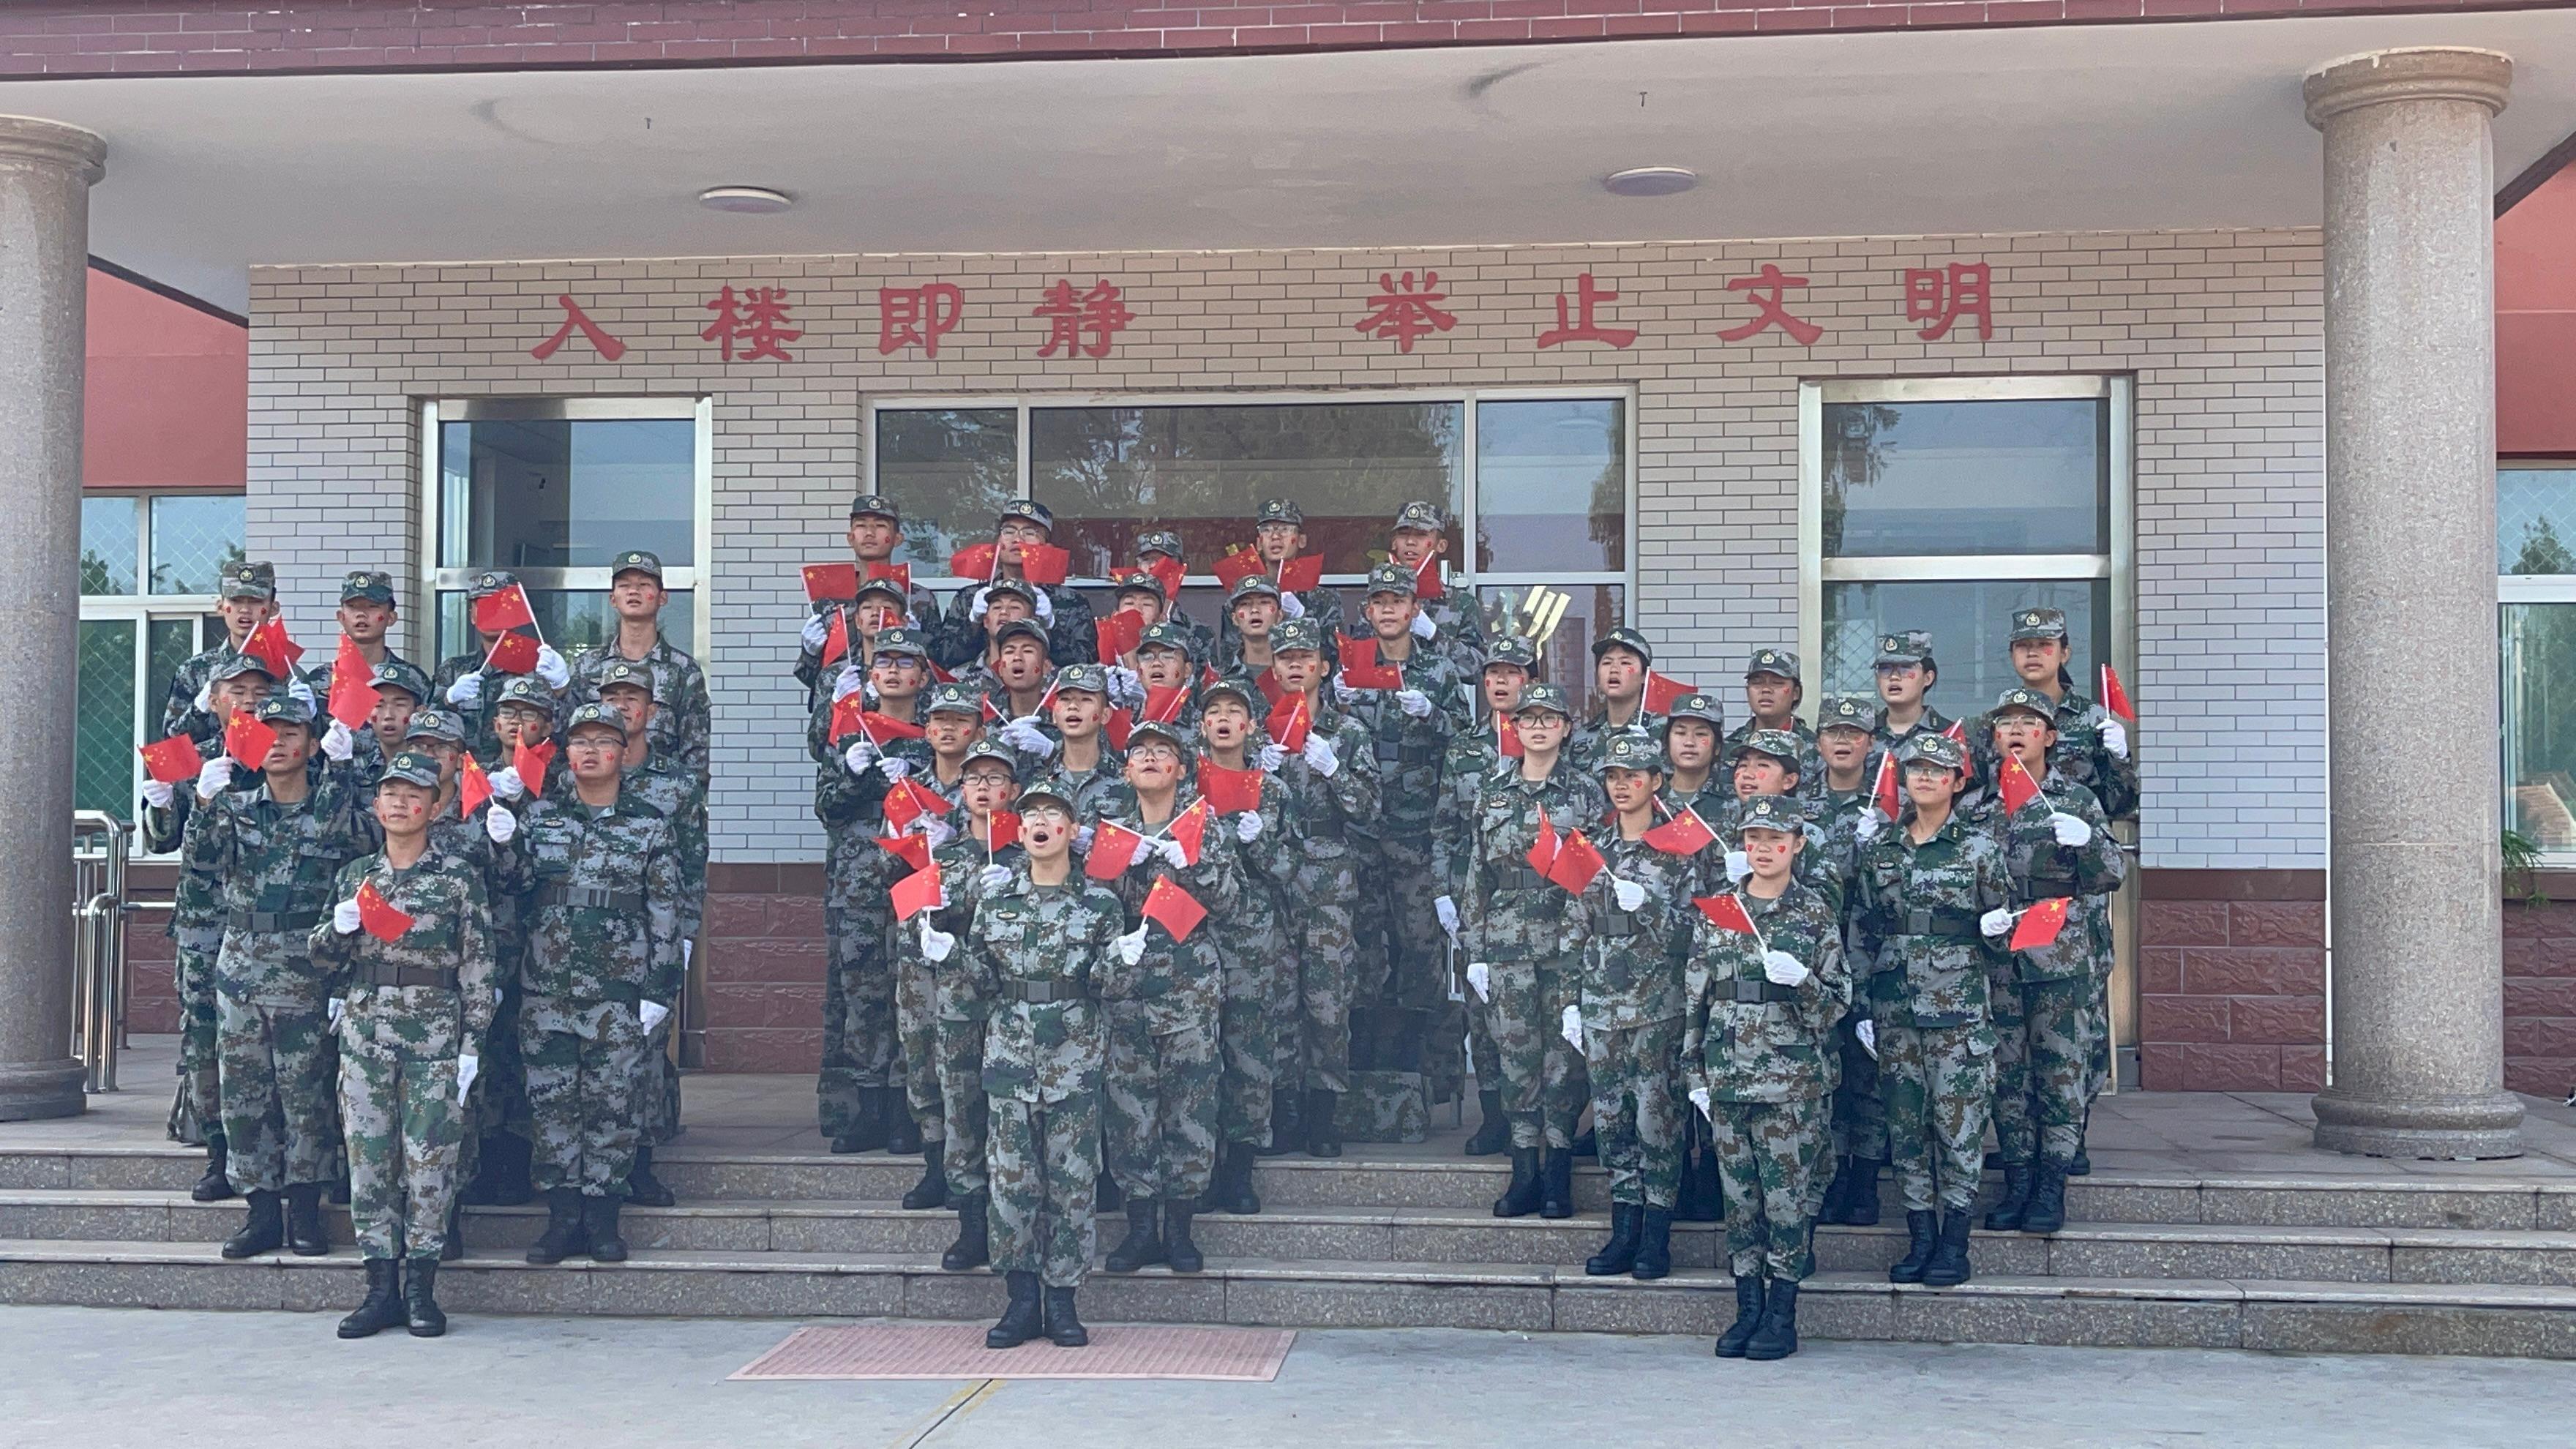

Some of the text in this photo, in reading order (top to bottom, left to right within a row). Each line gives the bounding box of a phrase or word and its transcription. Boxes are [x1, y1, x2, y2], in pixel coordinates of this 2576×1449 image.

[531, 261, 1992, 361] 入楼即静 举止文明
